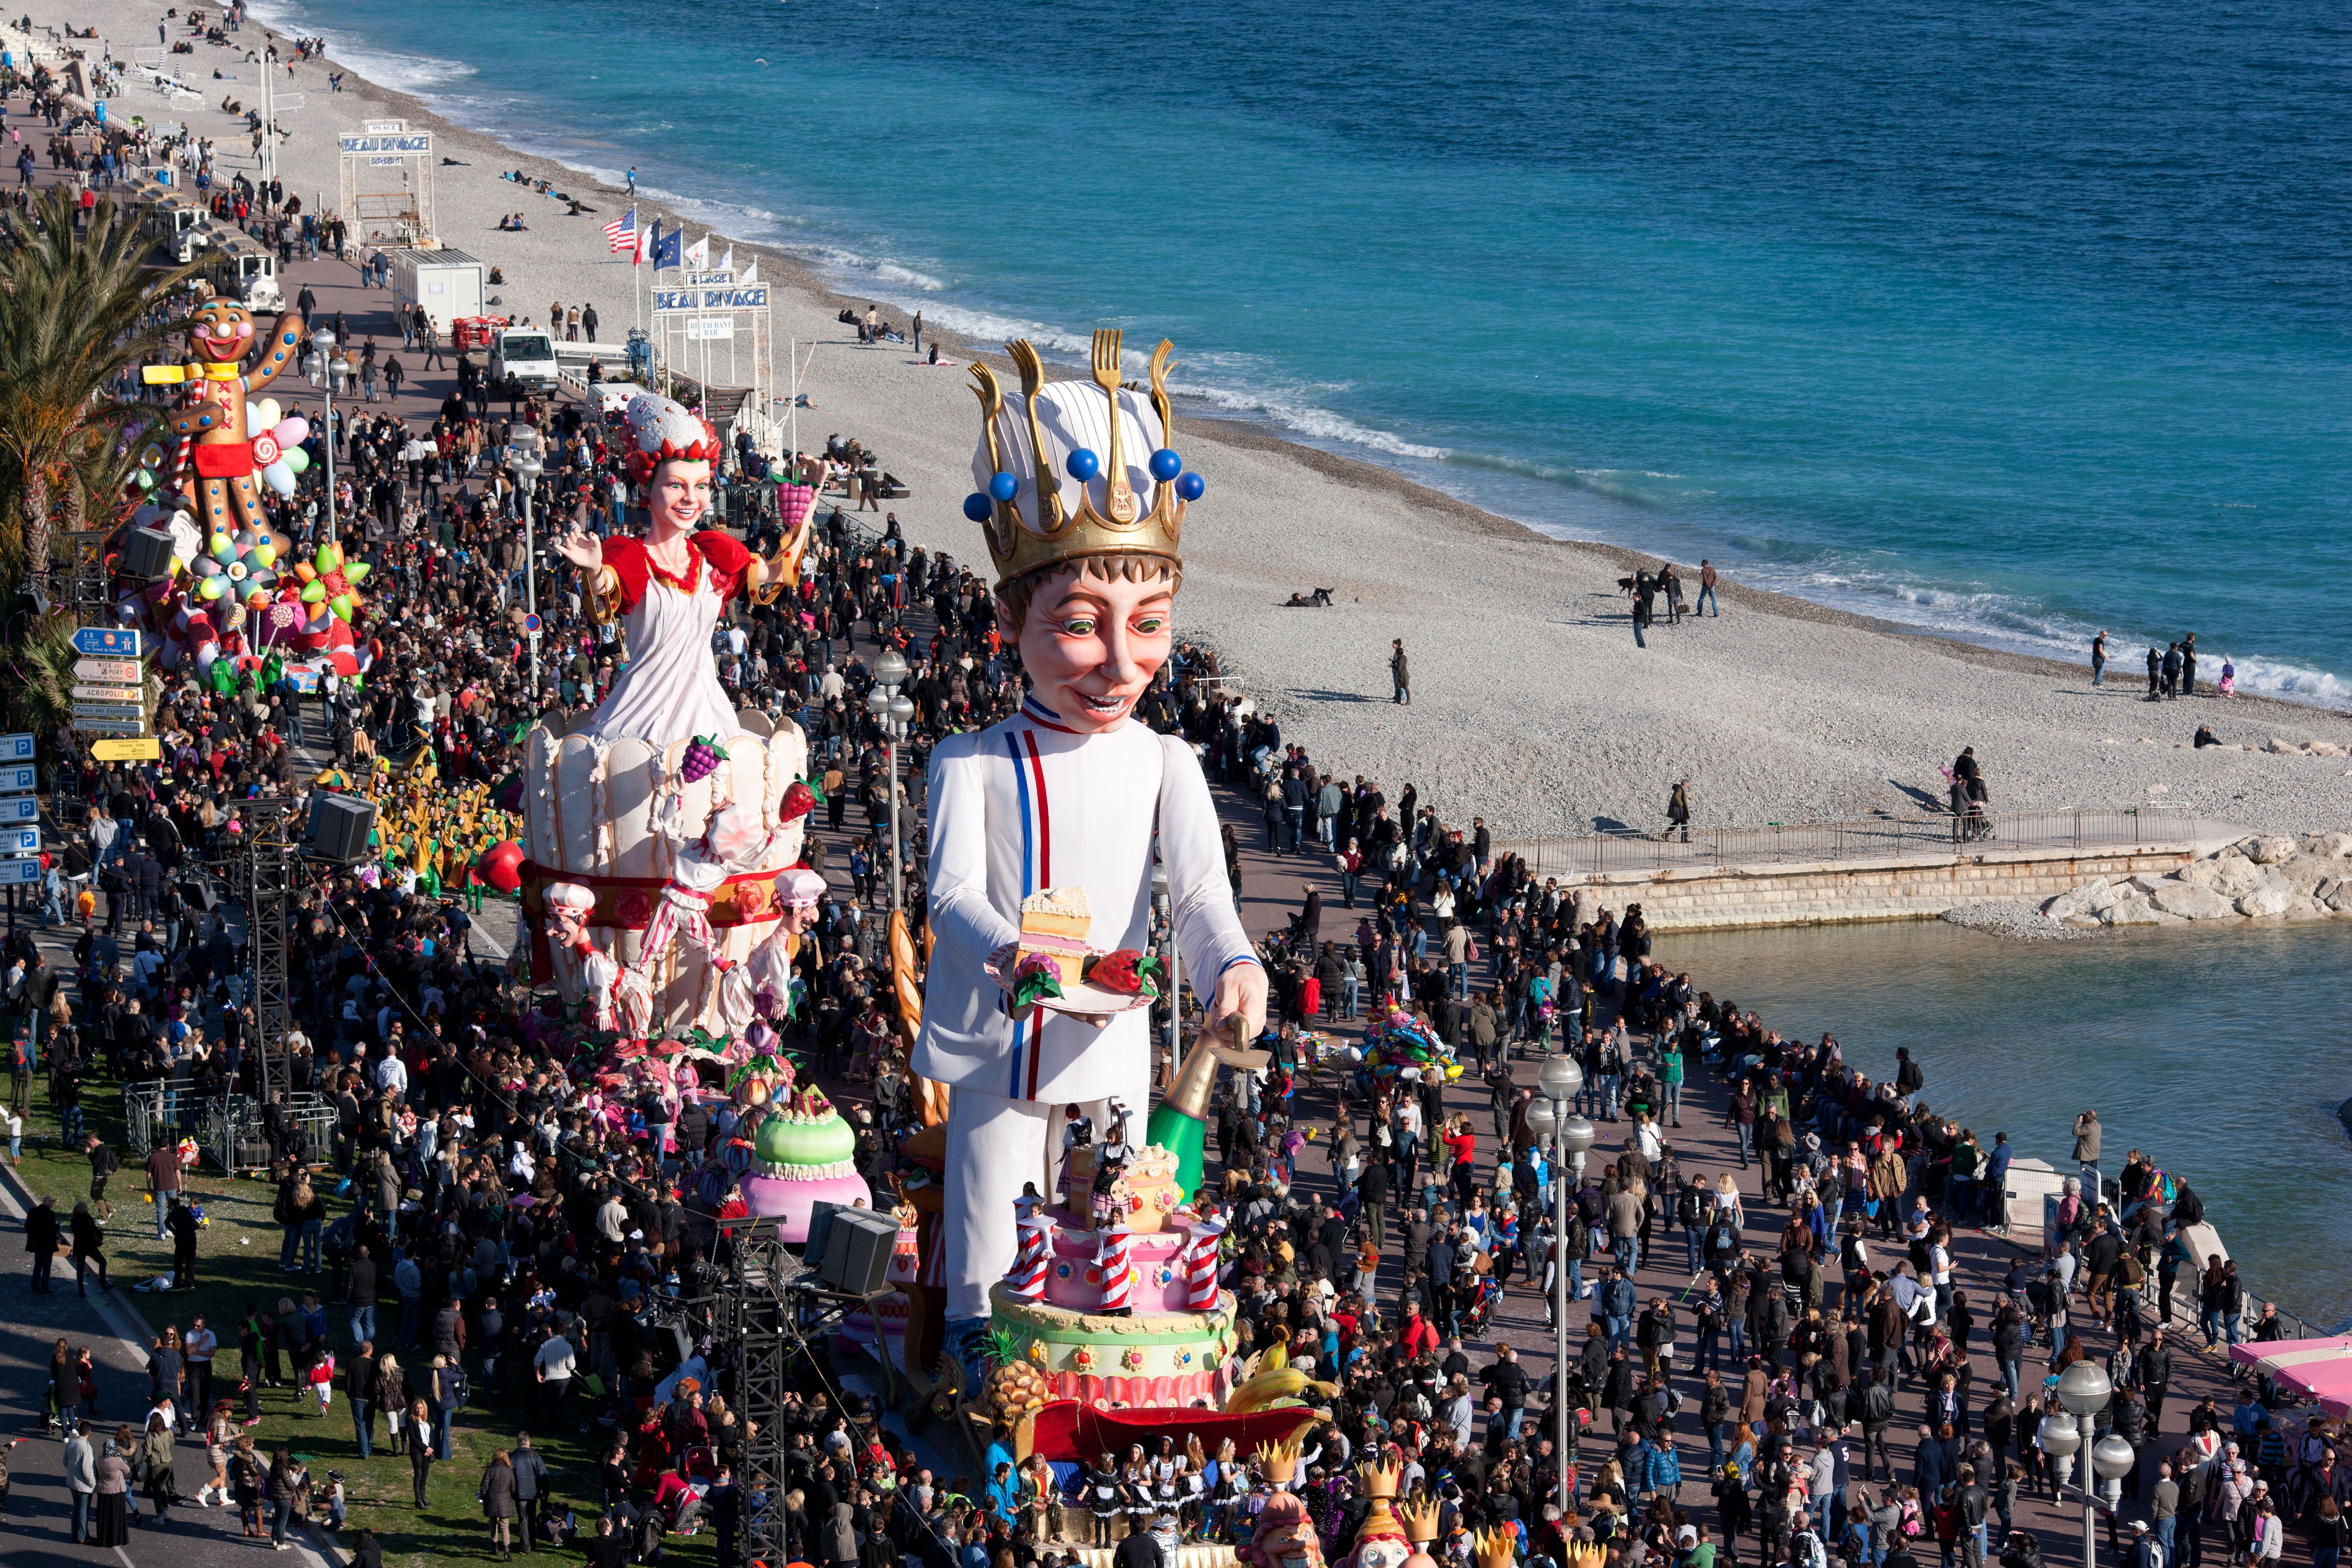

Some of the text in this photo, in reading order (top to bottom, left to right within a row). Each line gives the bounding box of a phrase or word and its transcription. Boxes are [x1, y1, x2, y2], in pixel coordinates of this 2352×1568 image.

[344, 137, 427, 151] BEAU RIVAGE
[692, 274, 727, 283] PLAGE
[658, 289, 764, 309] BEAU RIVAGE
[18, 741, 28, 753] P
[22, 803, 31, 815] P
[23, 834, 33, 846] P
[25, 865, 34, 877] P
[1841, 1447, 1849, 1461] 5
